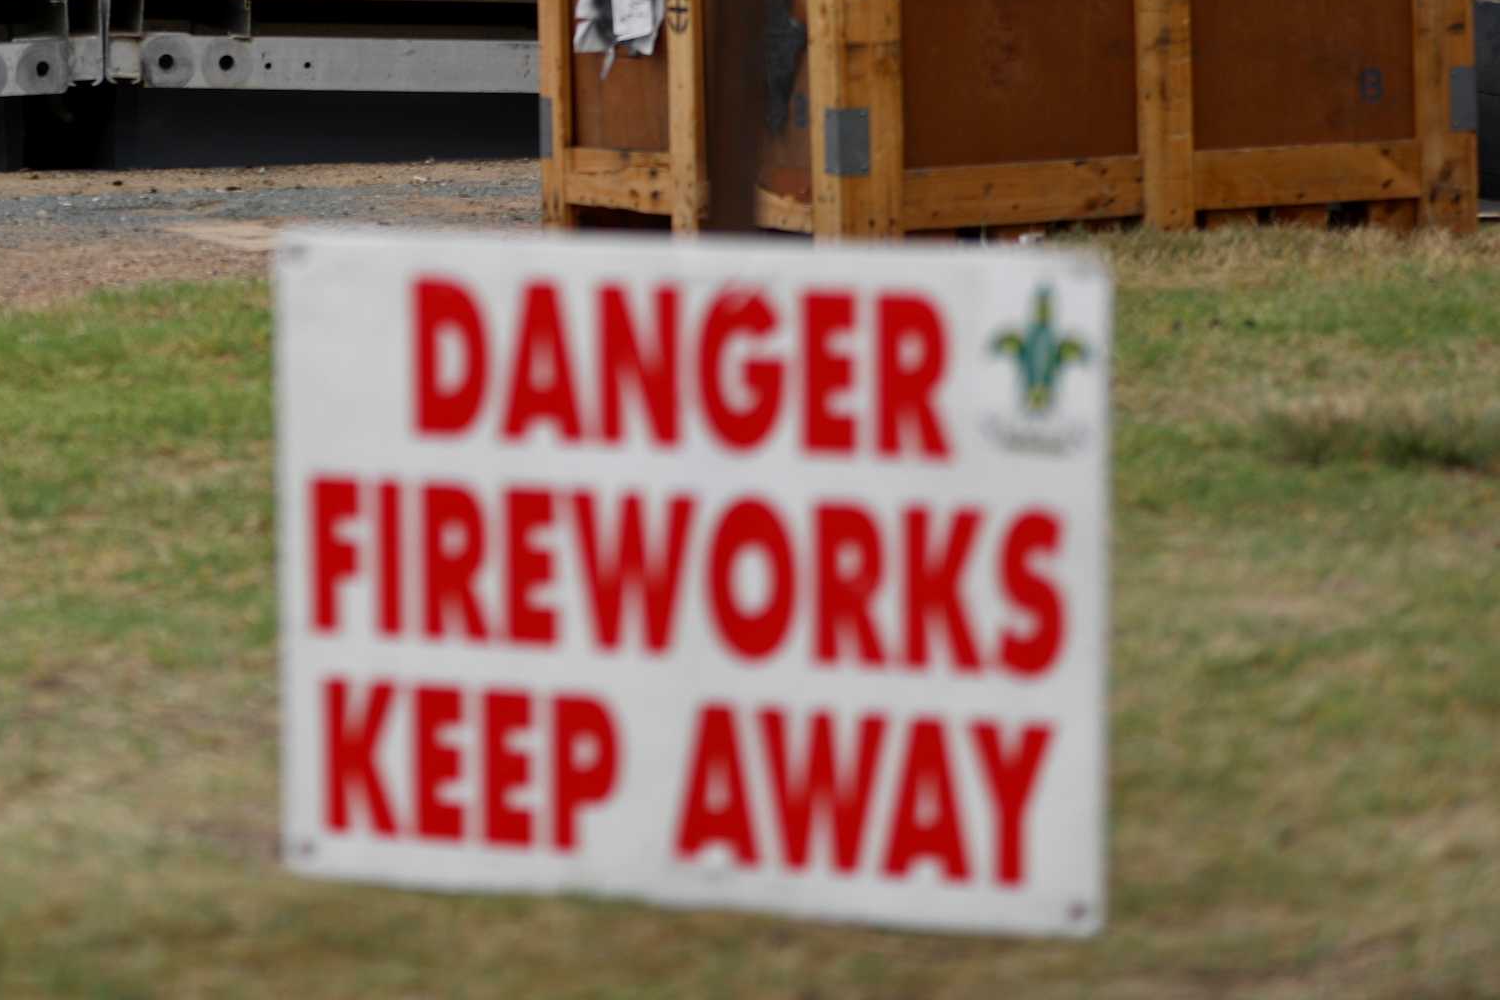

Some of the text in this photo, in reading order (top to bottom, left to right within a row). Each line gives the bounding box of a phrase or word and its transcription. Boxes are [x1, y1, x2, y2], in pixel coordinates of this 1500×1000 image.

[411, 273, 953, 462] DANGER
[308, 474, 1067, 681] FIREWORKS
[322, 675, 1054, 889] KEEP AWAY
